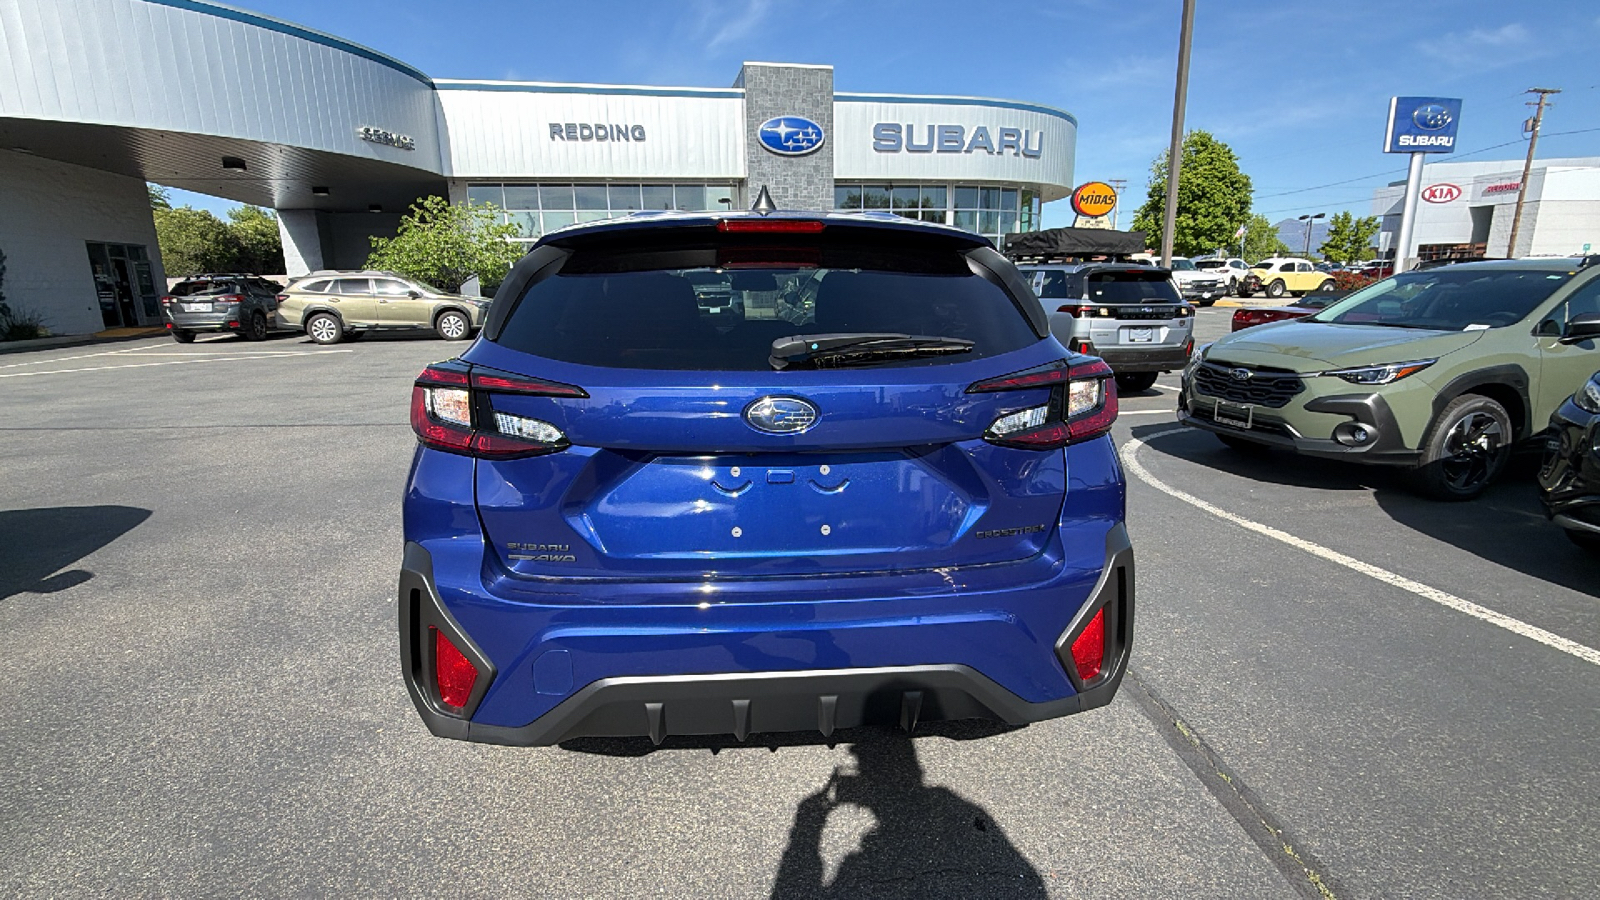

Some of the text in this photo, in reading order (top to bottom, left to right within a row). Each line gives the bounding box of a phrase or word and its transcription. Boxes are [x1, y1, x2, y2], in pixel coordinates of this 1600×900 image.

[360, 126, 416, 150] SERVICE
[548, 122, 647, 142] REDDING
[872, 122, 1044, 159] SUBARU
[1399, 134, 1454, 146] SUBARU
[1080, 192, 1117, 205] MIDAS
[1428, 187, 1455, 199] KIA
[976, 523, 1046, 539] CROSSTREK
[507, 542, 571, 552] SUBARU
